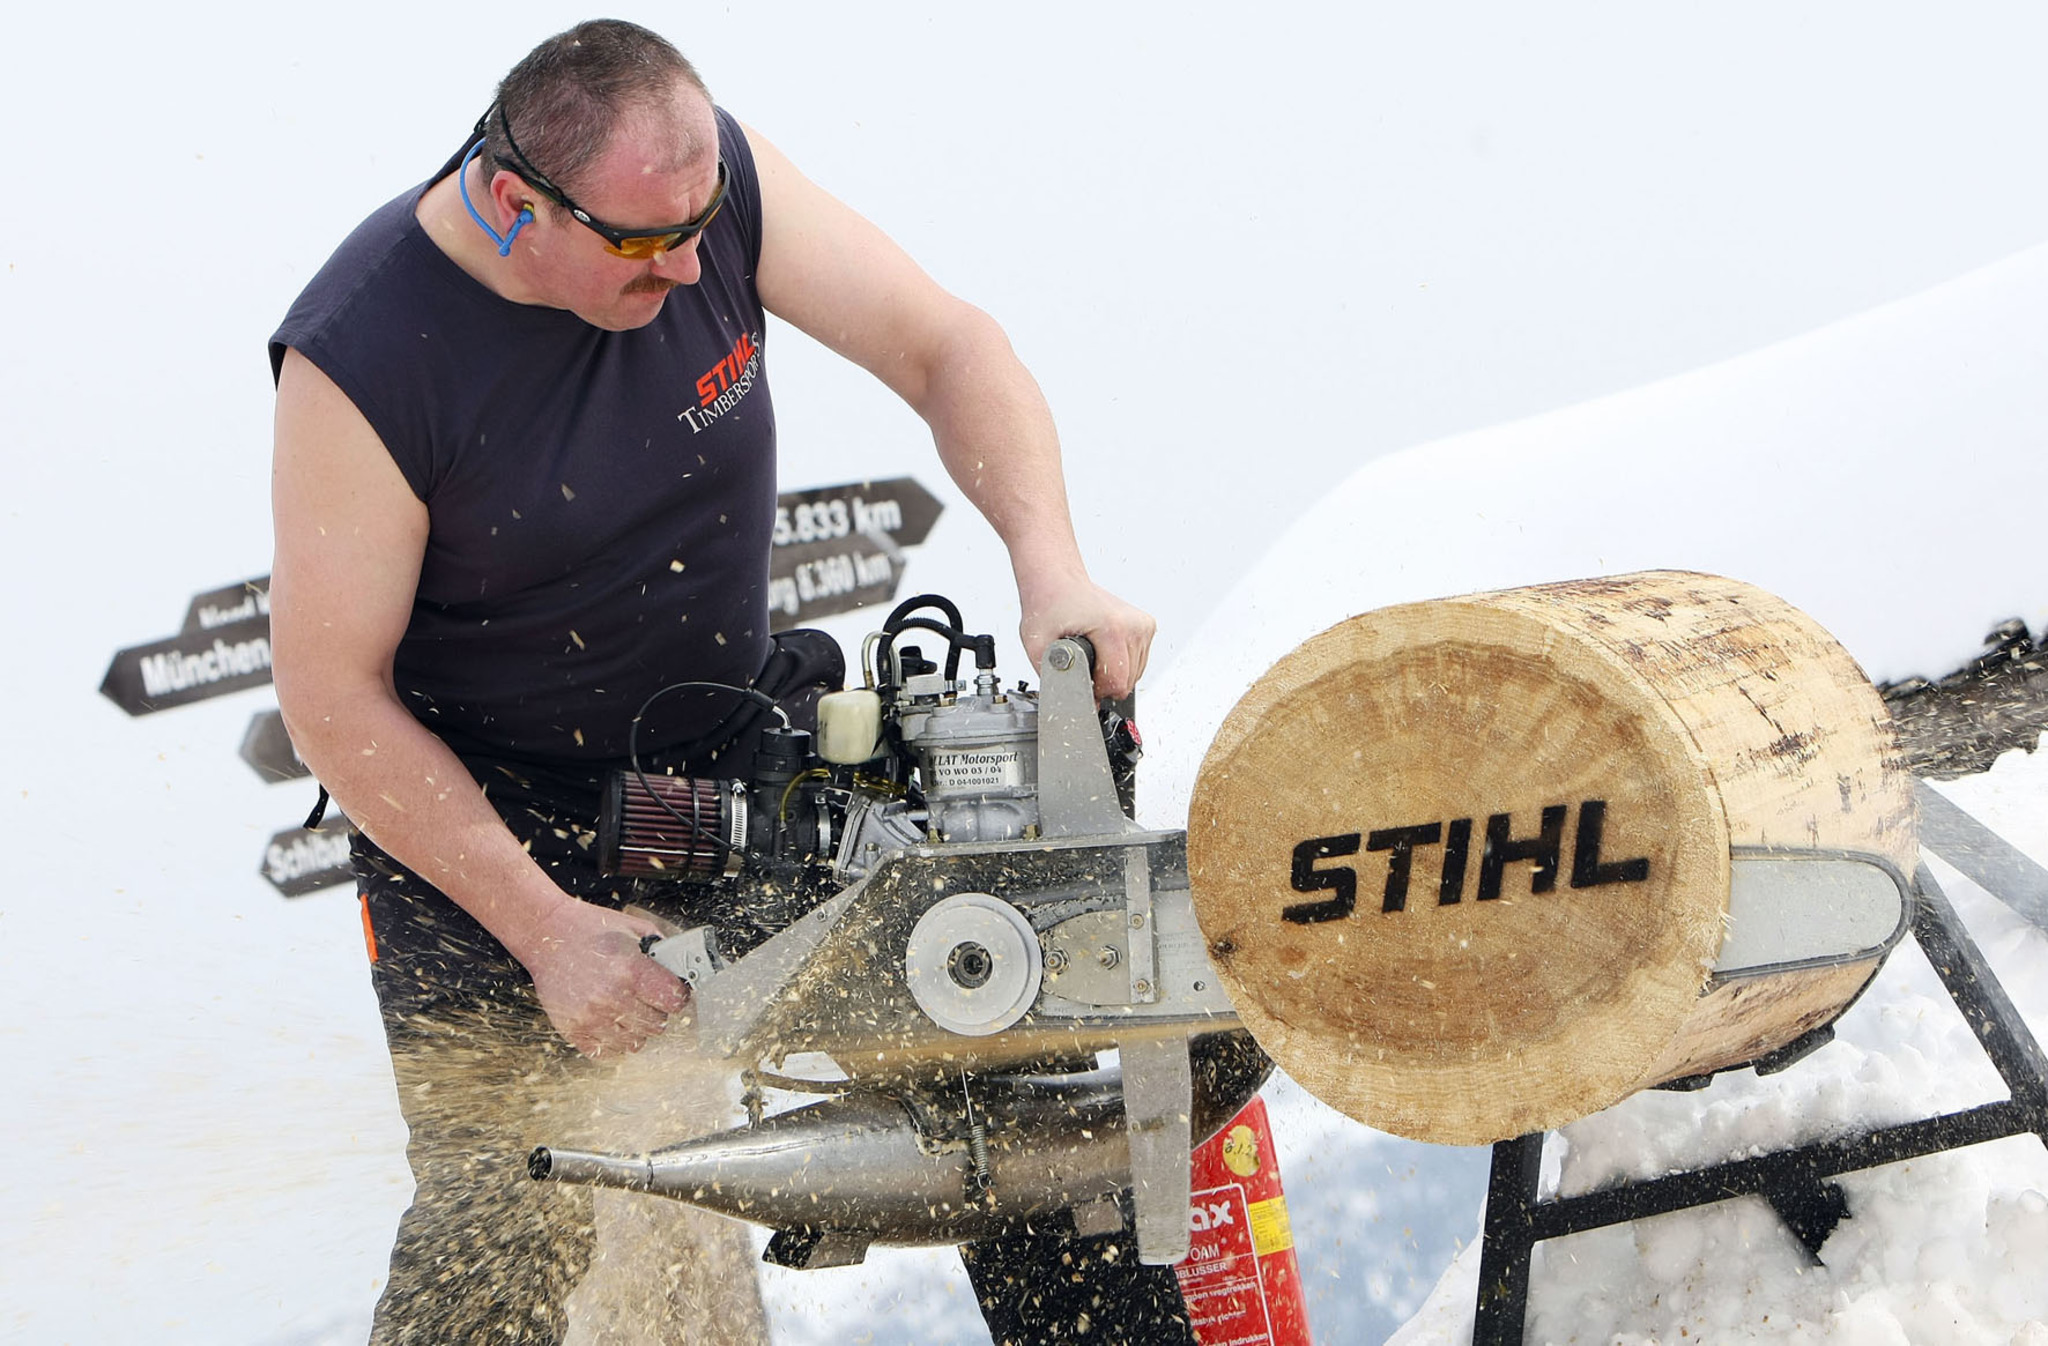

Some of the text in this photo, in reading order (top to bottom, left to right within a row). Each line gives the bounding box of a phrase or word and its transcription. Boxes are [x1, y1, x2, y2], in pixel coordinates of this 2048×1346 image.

[696, 332, 757, 408] STIHL
[852, 496, 902, 535] km
[140, 637, 271, 697] München
[960, 751, 1018, 766] Motorsport
[1281, 799, 1650, 925] STIHL
[1190, 1243, 1220, 1261] OAM
